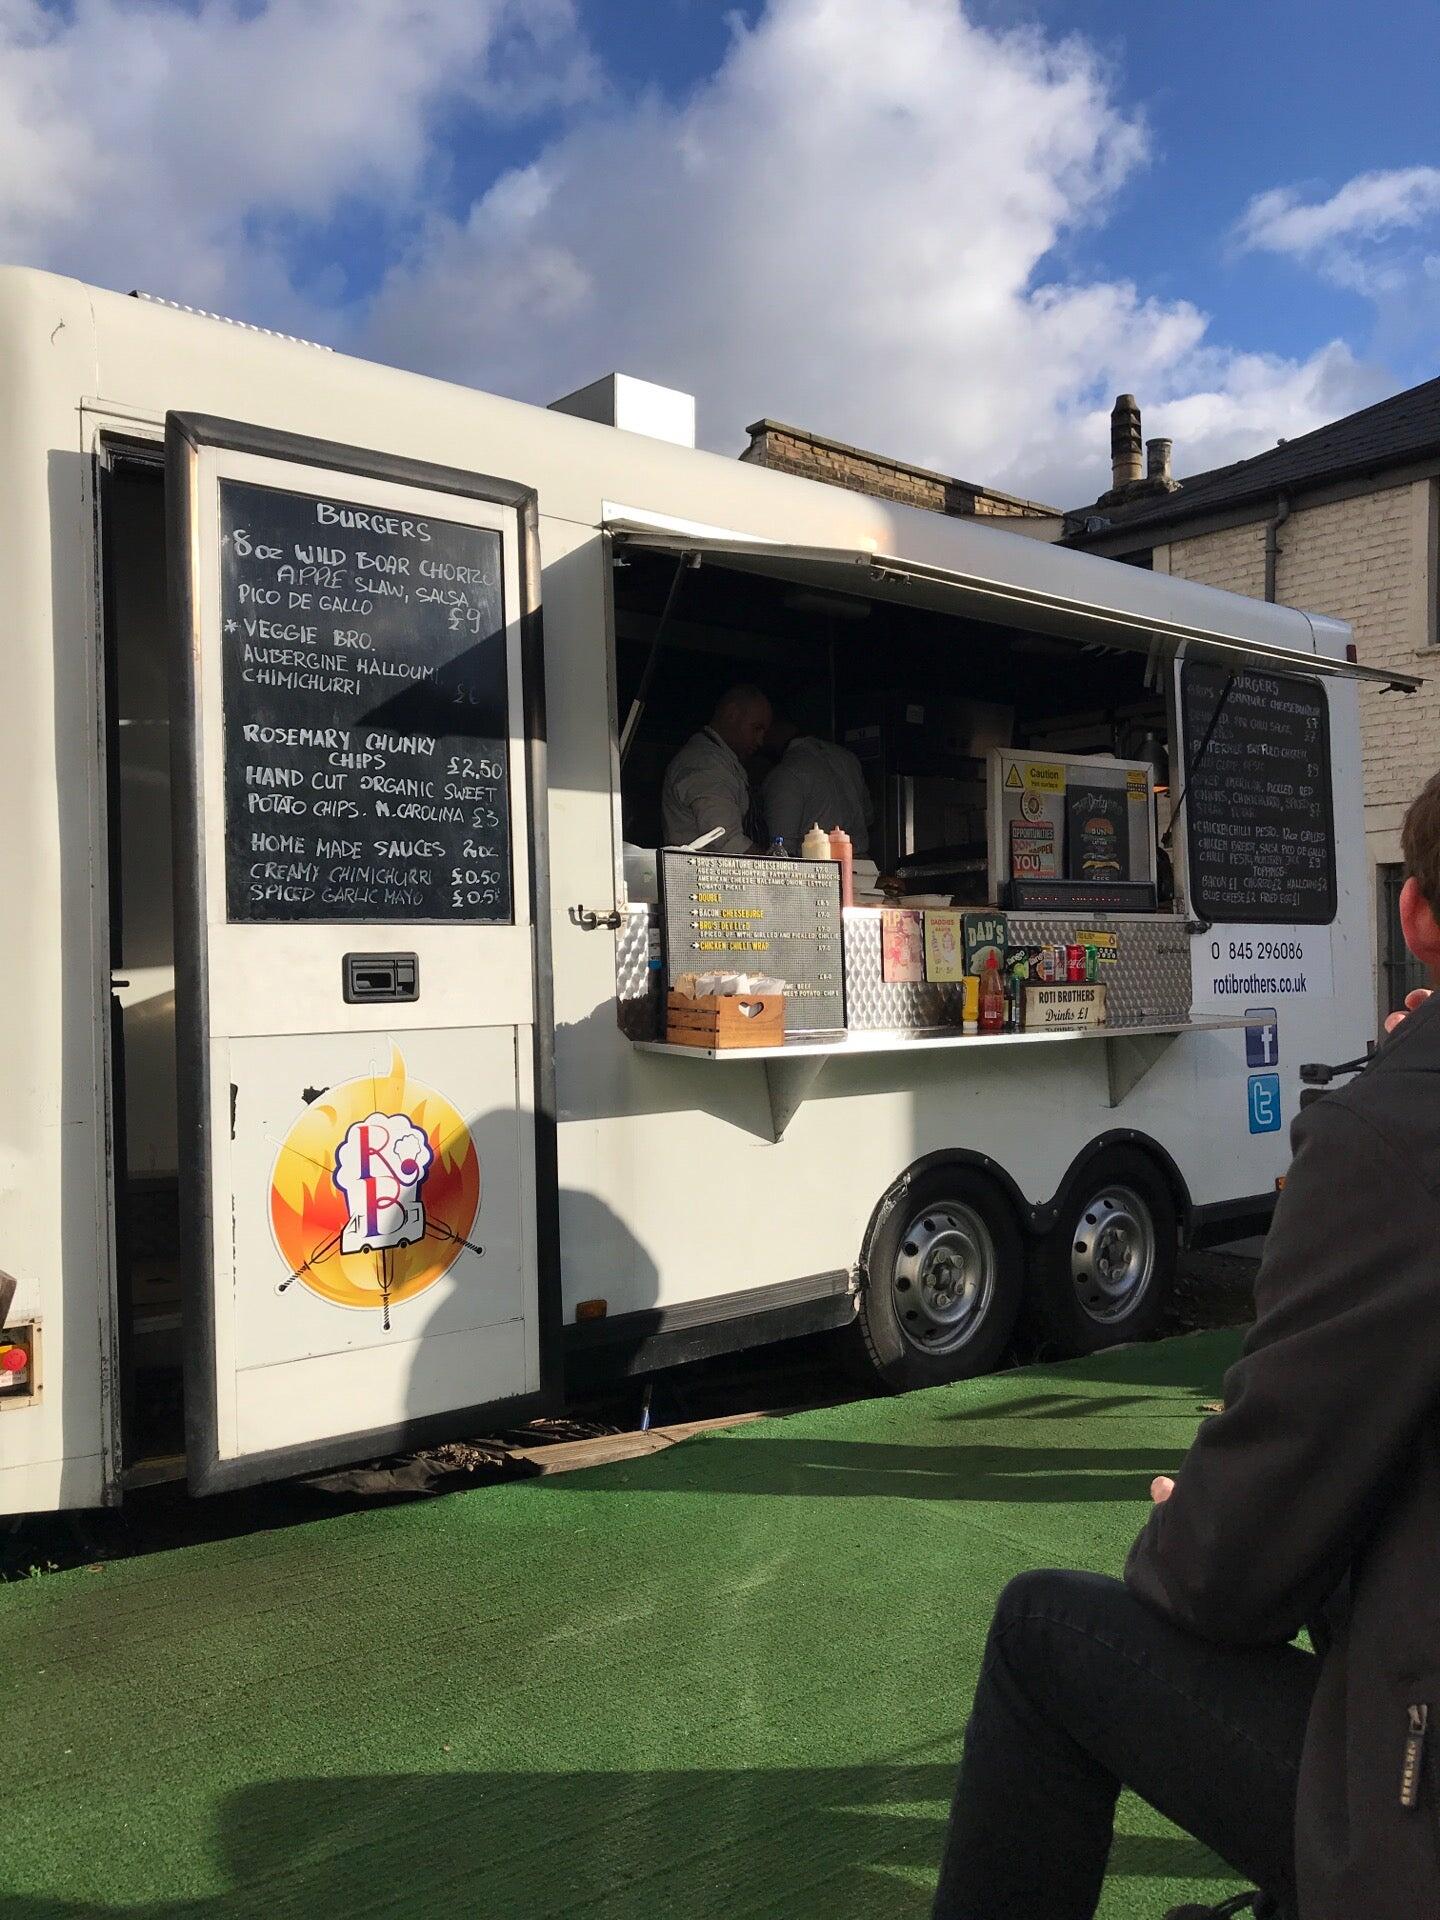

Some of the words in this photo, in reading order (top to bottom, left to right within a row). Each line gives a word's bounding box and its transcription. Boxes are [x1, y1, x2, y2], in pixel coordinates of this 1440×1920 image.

[317, 502, 431, 542] BURGERS
[295, 543, 347, 566] WILD
[355, 551, 410, 577] BOAR
[238, 583, 281, 606] PICO
[288, 591, 312, 611] DE
[319, 593, 374, 616] GALLO
[277, 564, 348, 590] APPLE
[355, 577, 410, 604] SLAW,
[416, 586, 470, 608] SALSA
[448, 608, 482, 634] £9
[243, 618, 318, 646] VEGGIE
[333, 629, 377, 652] BRO.
[243, 644, 349, 673] AUBERGINE
[242, 668, 361, 696] CHIMICHURRI
[243, 724, 352, 750] ROSEMARY
[366, 732, 437, 757] CHUNKY
[328, 751, 387, 771] CHIPS
[447, 756, 504, 781] £2.50
[1030, 768, 1059, 780] Caution
[246, 765, 305, 789] HAND
[311, 771, 349, 791] CUT
[360, 775, 435, 799] ORGANIC
[444, 782, 498, 802] SWEET
[248, 792, 308, 816] POTATO
[473, 806, 500, 829] £3
[251, 832, 305, 855] HOME
[316, 838, 363, 860] MADE
[374, 840, 447, 858] SAUCES
[250, 861, 319, 883] CREAMY
[328, 865, 433, 887] CHIMICHURRI
[450, 867, 501, 886] £0.50
[1014, 855, 1040, 870] YOU
[250, 883, 316, 903] SPICED
[322, 887, 379, 906] GARLIC
[384, 887, 424, 906] MAYO
[698, 908, 719, 918] BACON
[700, 941, 727, 951] CHICKEN
[968, 920, 1004, 947] DAD'S
[1211, 941, 1220, 960] 0
[1229, 942, 1253, 959] 845
[1257, 942, 1303, 960] 296086
[1039, 991, 1056, 1004] ROTI
[1057, 989, 1095, 1002] BROTHERS
[1213, 972, 1307, 994] rotibrothers.co.uk
[1045, 1008, 1075, 1022] Drinks
[1077, 1007, 1089, 1020] £1
